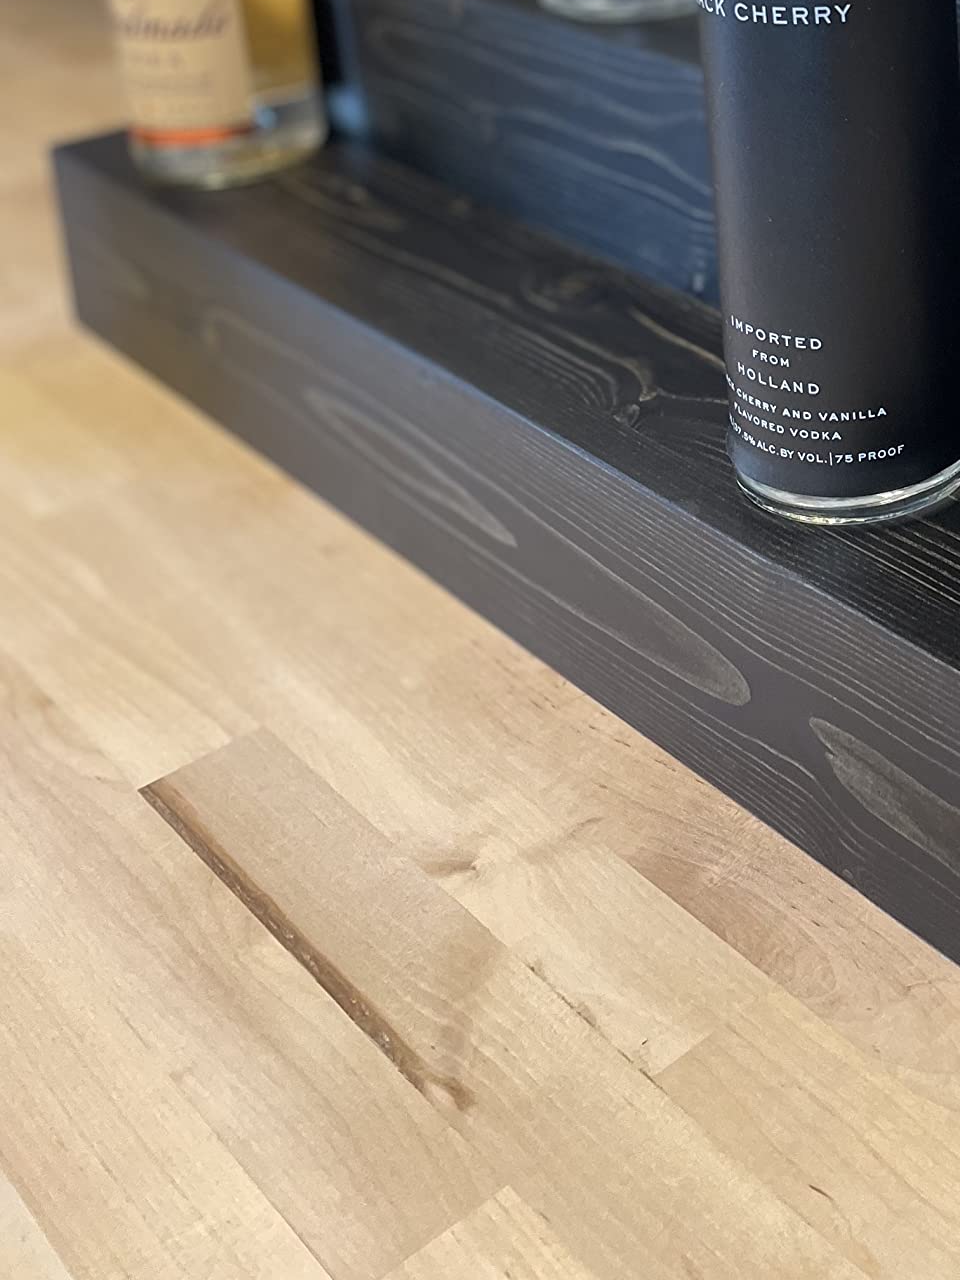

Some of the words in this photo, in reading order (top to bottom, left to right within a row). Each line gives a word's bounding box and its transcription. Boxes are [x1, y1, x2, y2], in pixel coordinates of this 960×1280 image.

[734, 3, 851, 25] CHERRY
[731, 315, 822, 350] IMPORTED
[752, 349, 790, 368] FROM
[737, 361, 820, 395] HOLLAND
[733, 401, 785, 435] FLAVORED
[789, 427, 842, 441] VODKA
[736, 387, 777, 413] CHERRY
[782, 408, 812, 420] AND
[819, 407, 887, 422] VANILLA
[858, 444, 905, 463] PROOF
